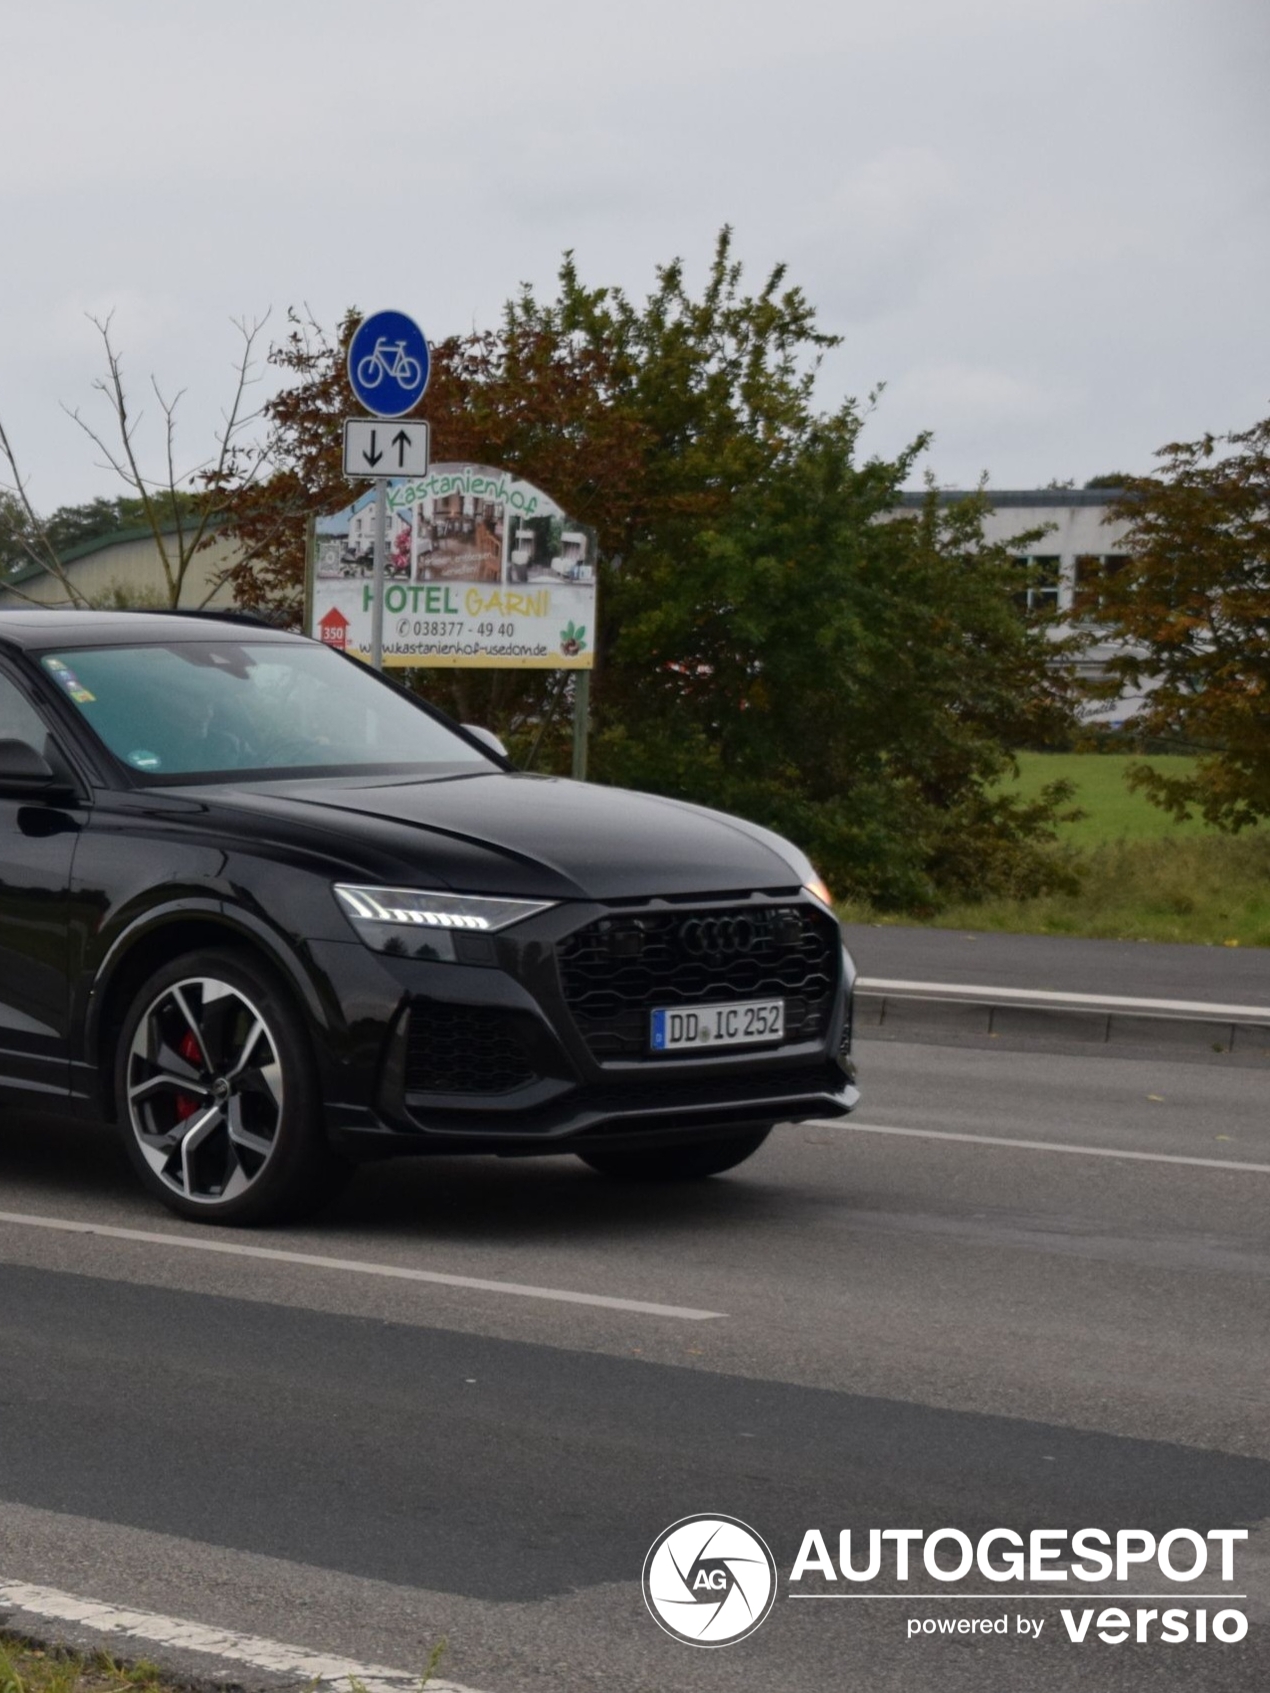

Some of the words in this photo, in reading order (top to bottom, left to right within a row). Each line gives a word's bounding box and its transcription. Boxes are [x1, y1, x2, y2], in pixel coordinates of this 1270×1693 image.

[386, 469, 537, 515] Kastanienhof
[465, 587, 549, 617] GARNI
[324, 627, 344, 640] 350
[413, 621, 464, 637] 038377
[477, 622, 493, 637] 49
[498, 622, 515, 637] 40
[359, 641, 547, 656] ww.kastanienhof-usedom.de
[670, 1013, 699, 1043] DD
[714, 1010, 738, 1039] IC
[743, 1006, 780, 1036] 252
